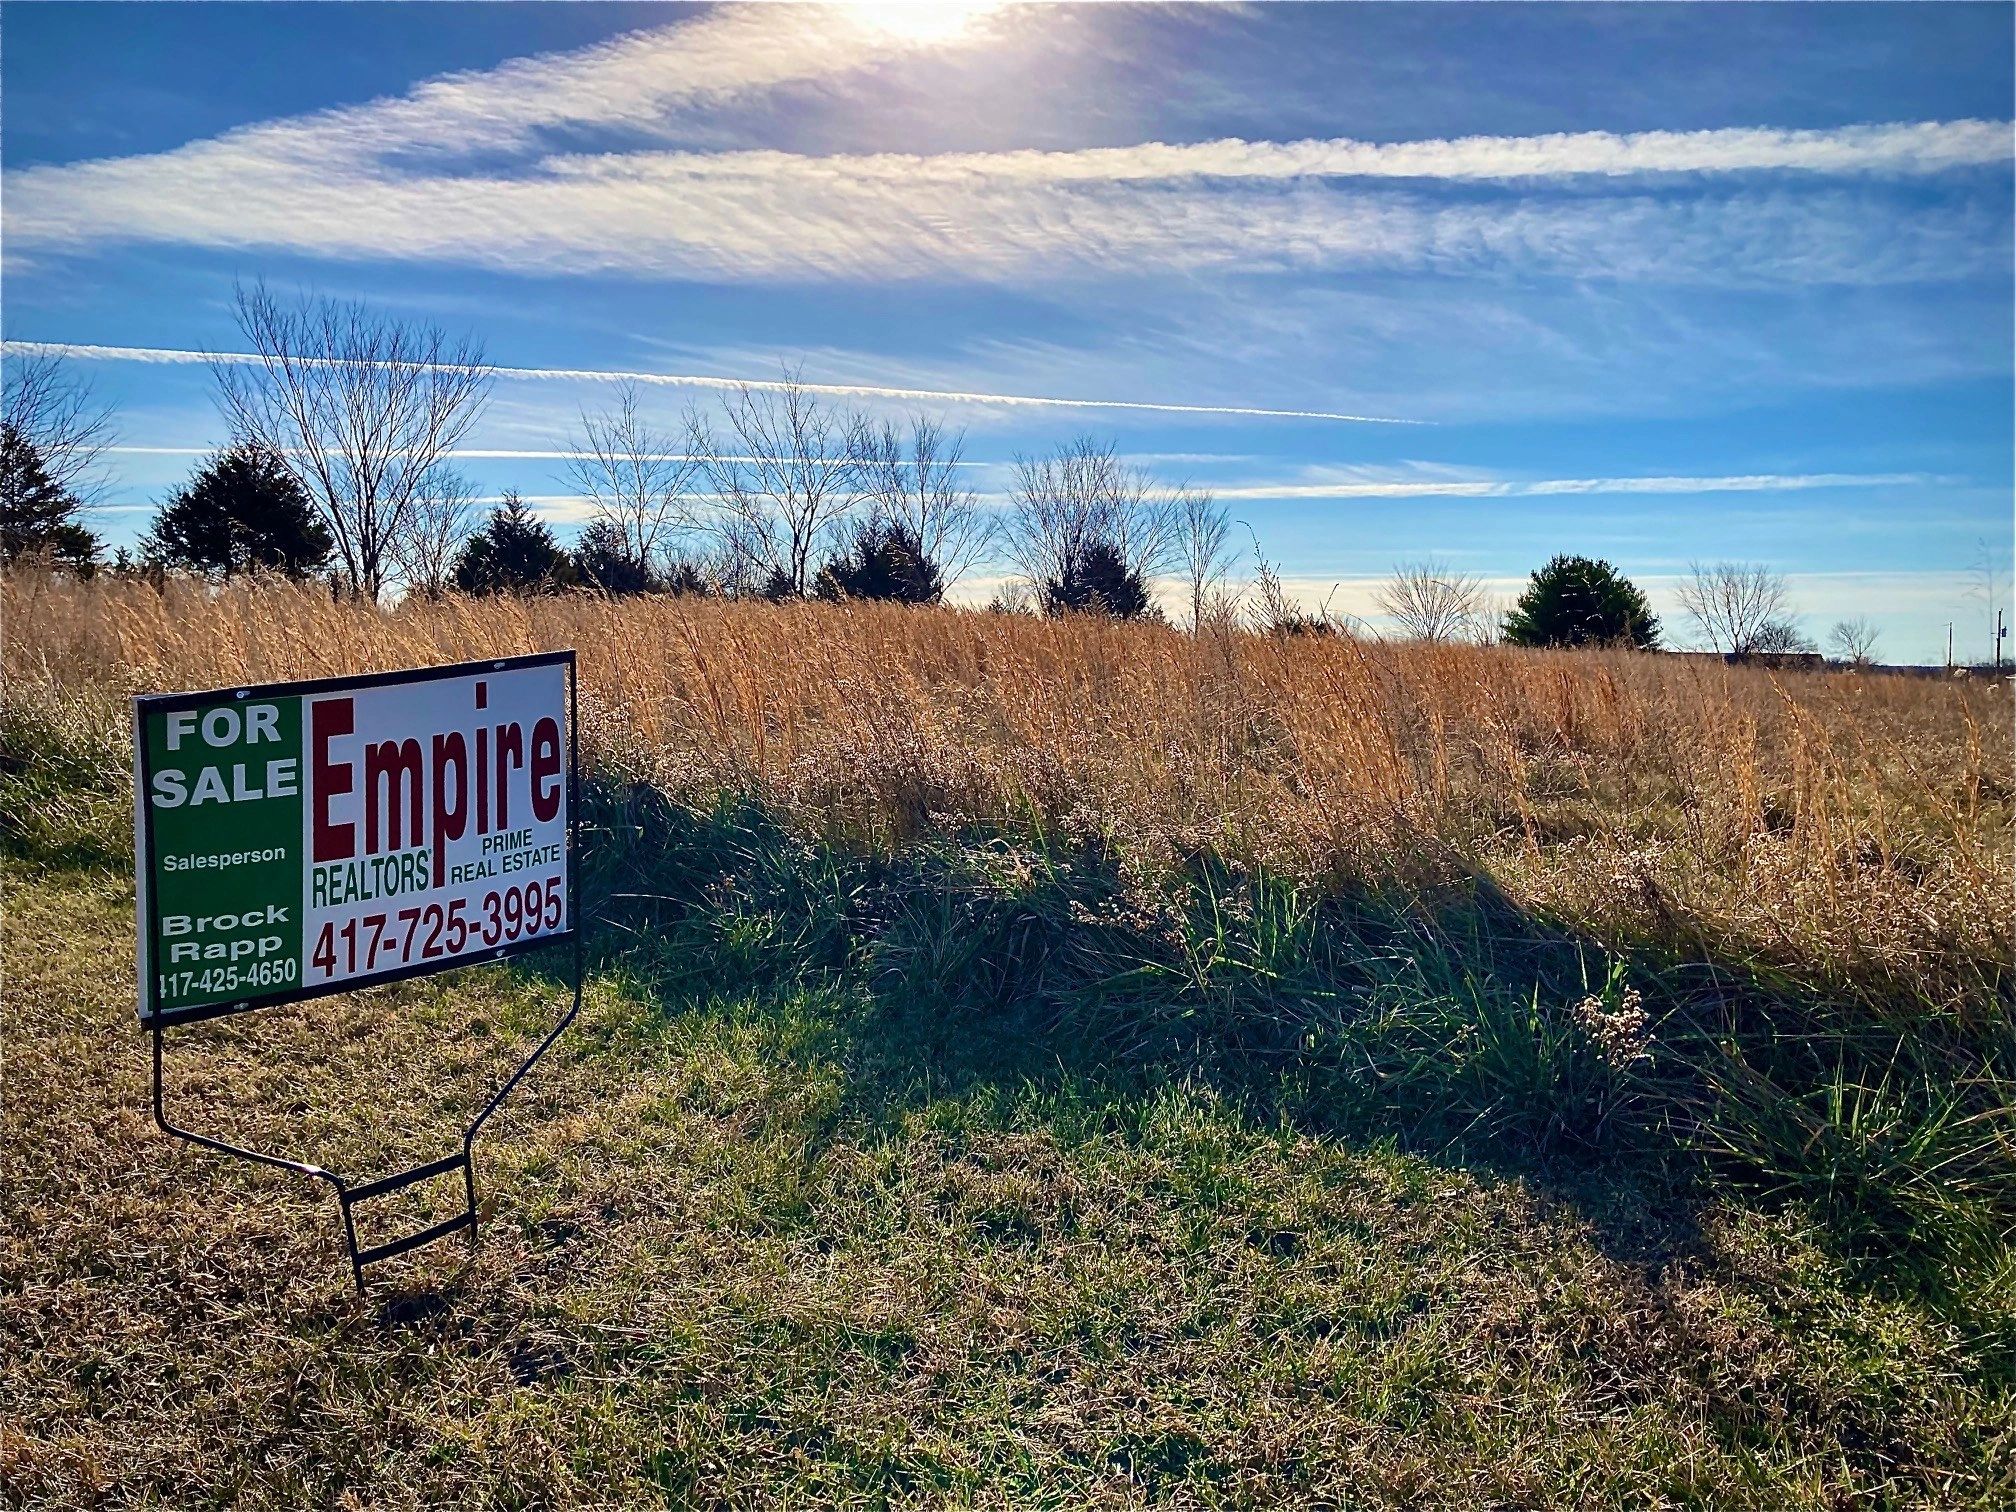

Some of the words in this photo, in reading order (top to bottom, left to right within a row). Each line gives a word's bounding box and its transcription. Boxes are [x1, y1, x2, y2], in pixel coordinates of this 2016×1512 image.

[166, 704, 281, 751] FOR
[152, 758, 298, 808] SALE
[312, 682, 561, 889] Empire
[163, 847, 286, 871] Salesperson
[482, 828, 533, 856] PRIME
[450, 864, 498, 885] REAL
[502, 844, 561, 875] ESTATE
[162, 905, 290, 936] Brock
[312, 876, 562, 978] 417-725-3995
[170, 935, 283, 963] Rapp
